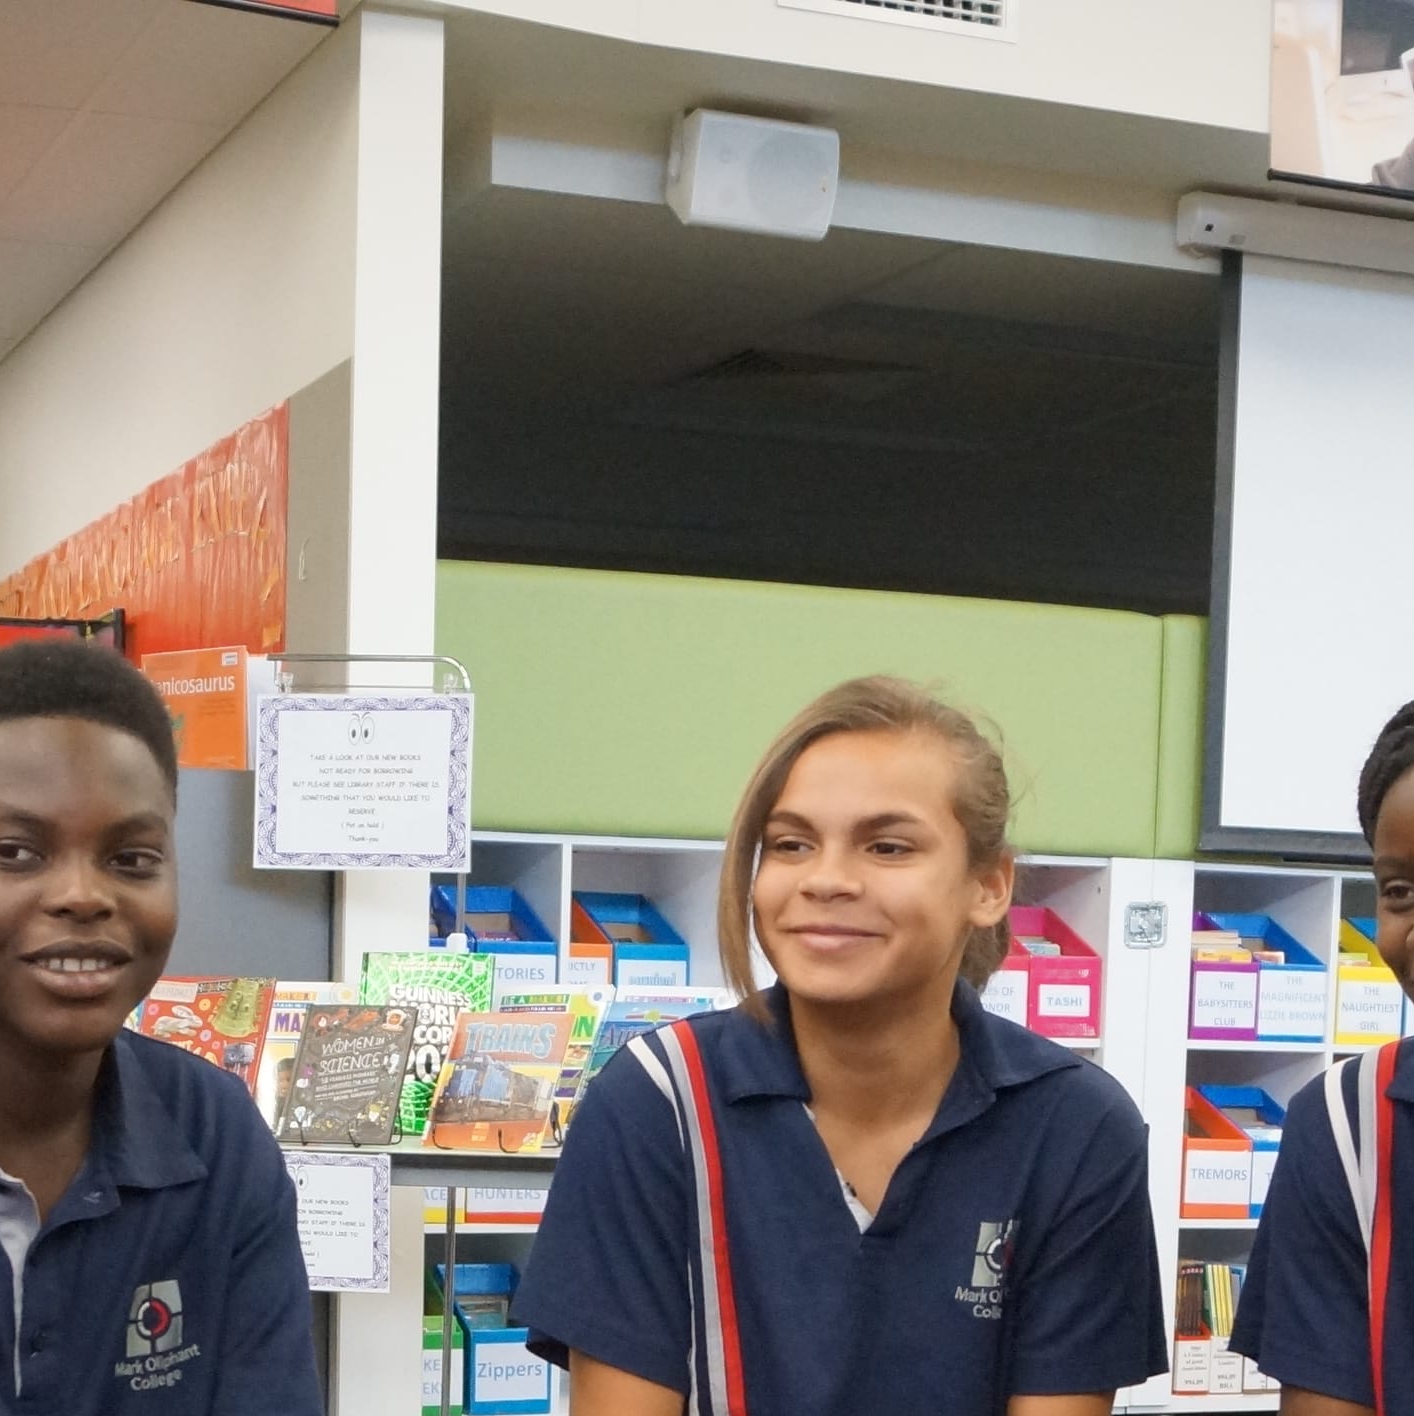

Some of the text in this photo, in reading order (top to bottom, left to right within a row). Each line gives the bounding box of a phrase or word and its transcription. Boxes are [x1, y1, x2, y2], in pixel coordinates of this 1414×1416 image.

[155, 675, 236, 697] anicosaurus
[569, 961, 596, 973] ICTLY
[496, 966, 545, 981] TORIES
[1219, 981, 1235, 990] THE
[1286, 976, 1303, 985] THE
[390, 984, 472, 1007] GUINNESS
[1261, 992, 1327, 1001] MAGNIFICENT
[1363, 987, 1380, 996] THE
[984, 1001, 1011, 1013] ONOR
[1045, 996, 1083, 1007] TASHI
[1197, 998, 1253, 1009] BABYSITTERS
[1341, 1003, 1400, 1013] NAUGHTIEST
[1214, 1017, 1236, 1026] CLUB
[1288, 1011, 1325, 1020] BROWN
[1360, 1021, 1380, 1031] GIRL
[322, 1035, 385, 1056] WOMEN IN
[465, 1022, 556, 1059] TRAINS
[320, 1052, 382, 1074] SCIENCE
[1191, 1167, 1248, 1181] TREMORS
[955, 1286, 987, 1304] Mark
[115, 1344, 201, 1378] Mark Oliphant
[477, 1361, 543, 1380] Zippers
[130, 1369, 182, 1391] College
